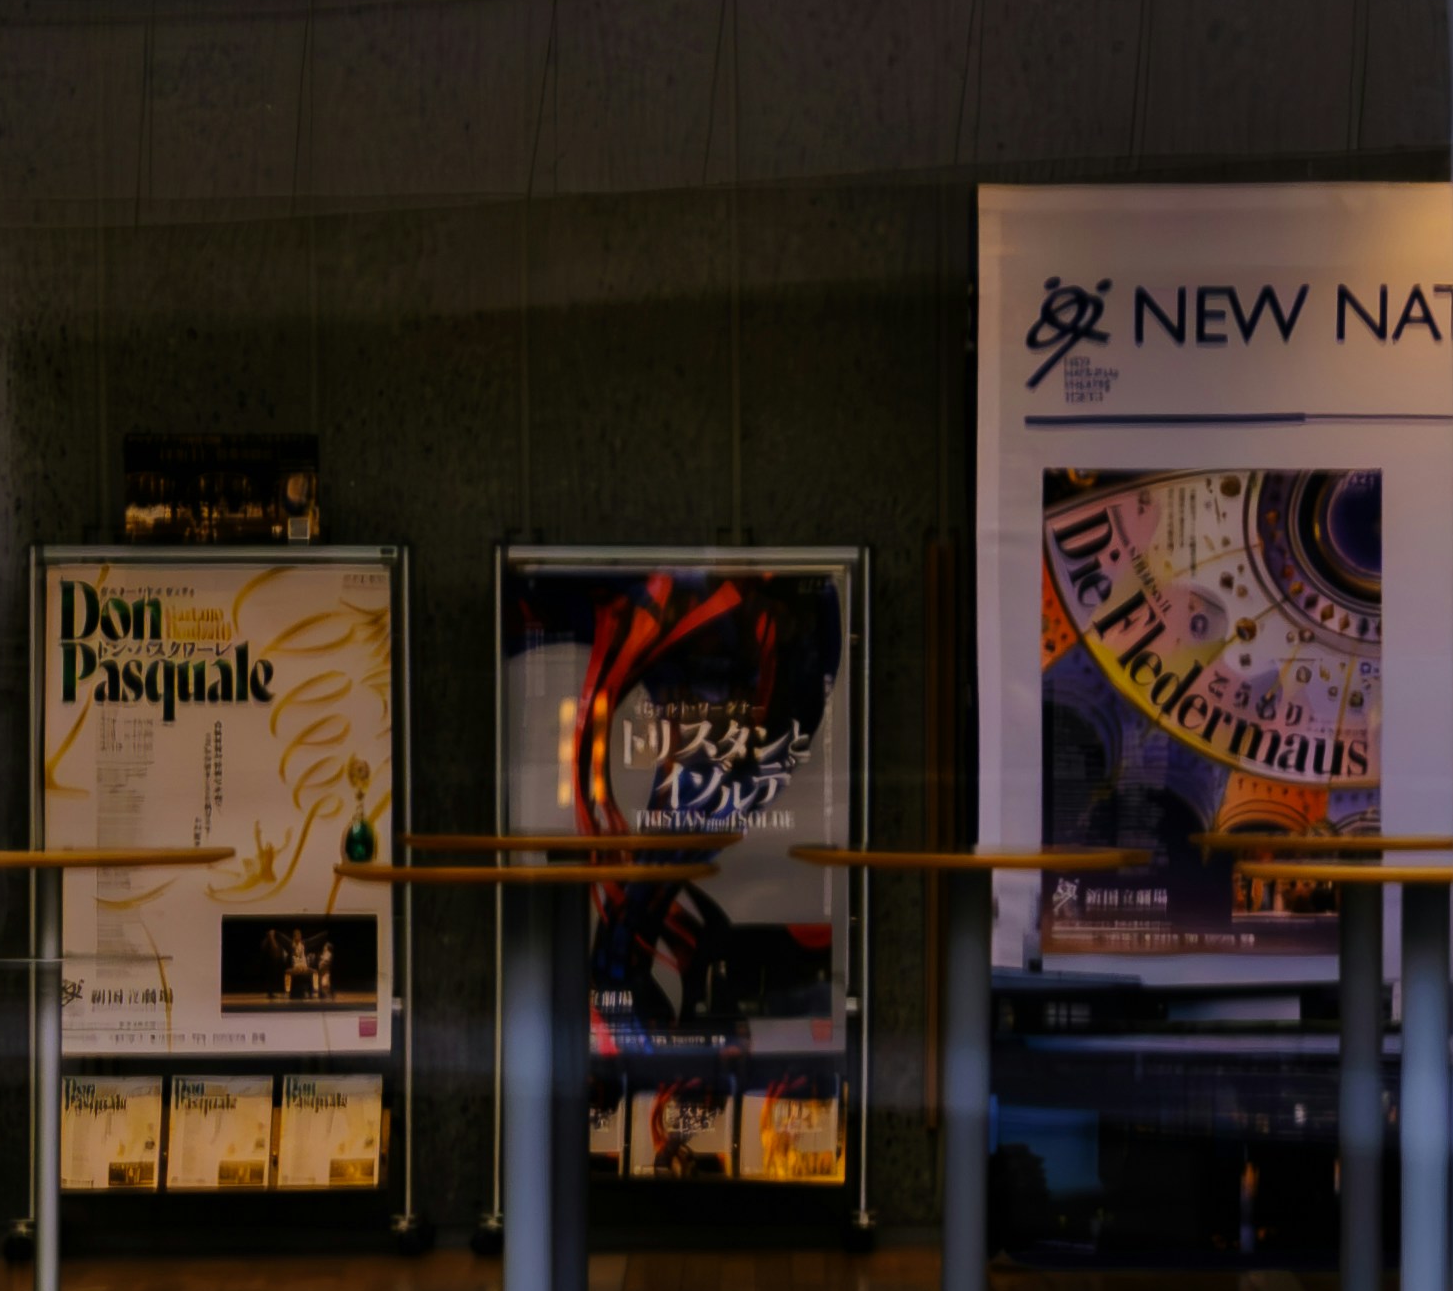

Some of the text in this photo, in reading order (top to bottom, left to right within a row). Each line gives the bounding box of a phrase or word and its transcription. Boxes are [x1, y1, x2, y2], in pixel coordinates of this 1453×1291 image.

[1133, 283, 1310, 344] NEW
[60, 577, 163, 641] Don
[1049, 505, 1115, 608] Die
[1092, 590, 1370, 777] Fledermaus
[60, 640, 276, 722] Pasquale
[621, 718, 812, 767] トリスタンと
[655, 756, 797, 814] イゾルデ
